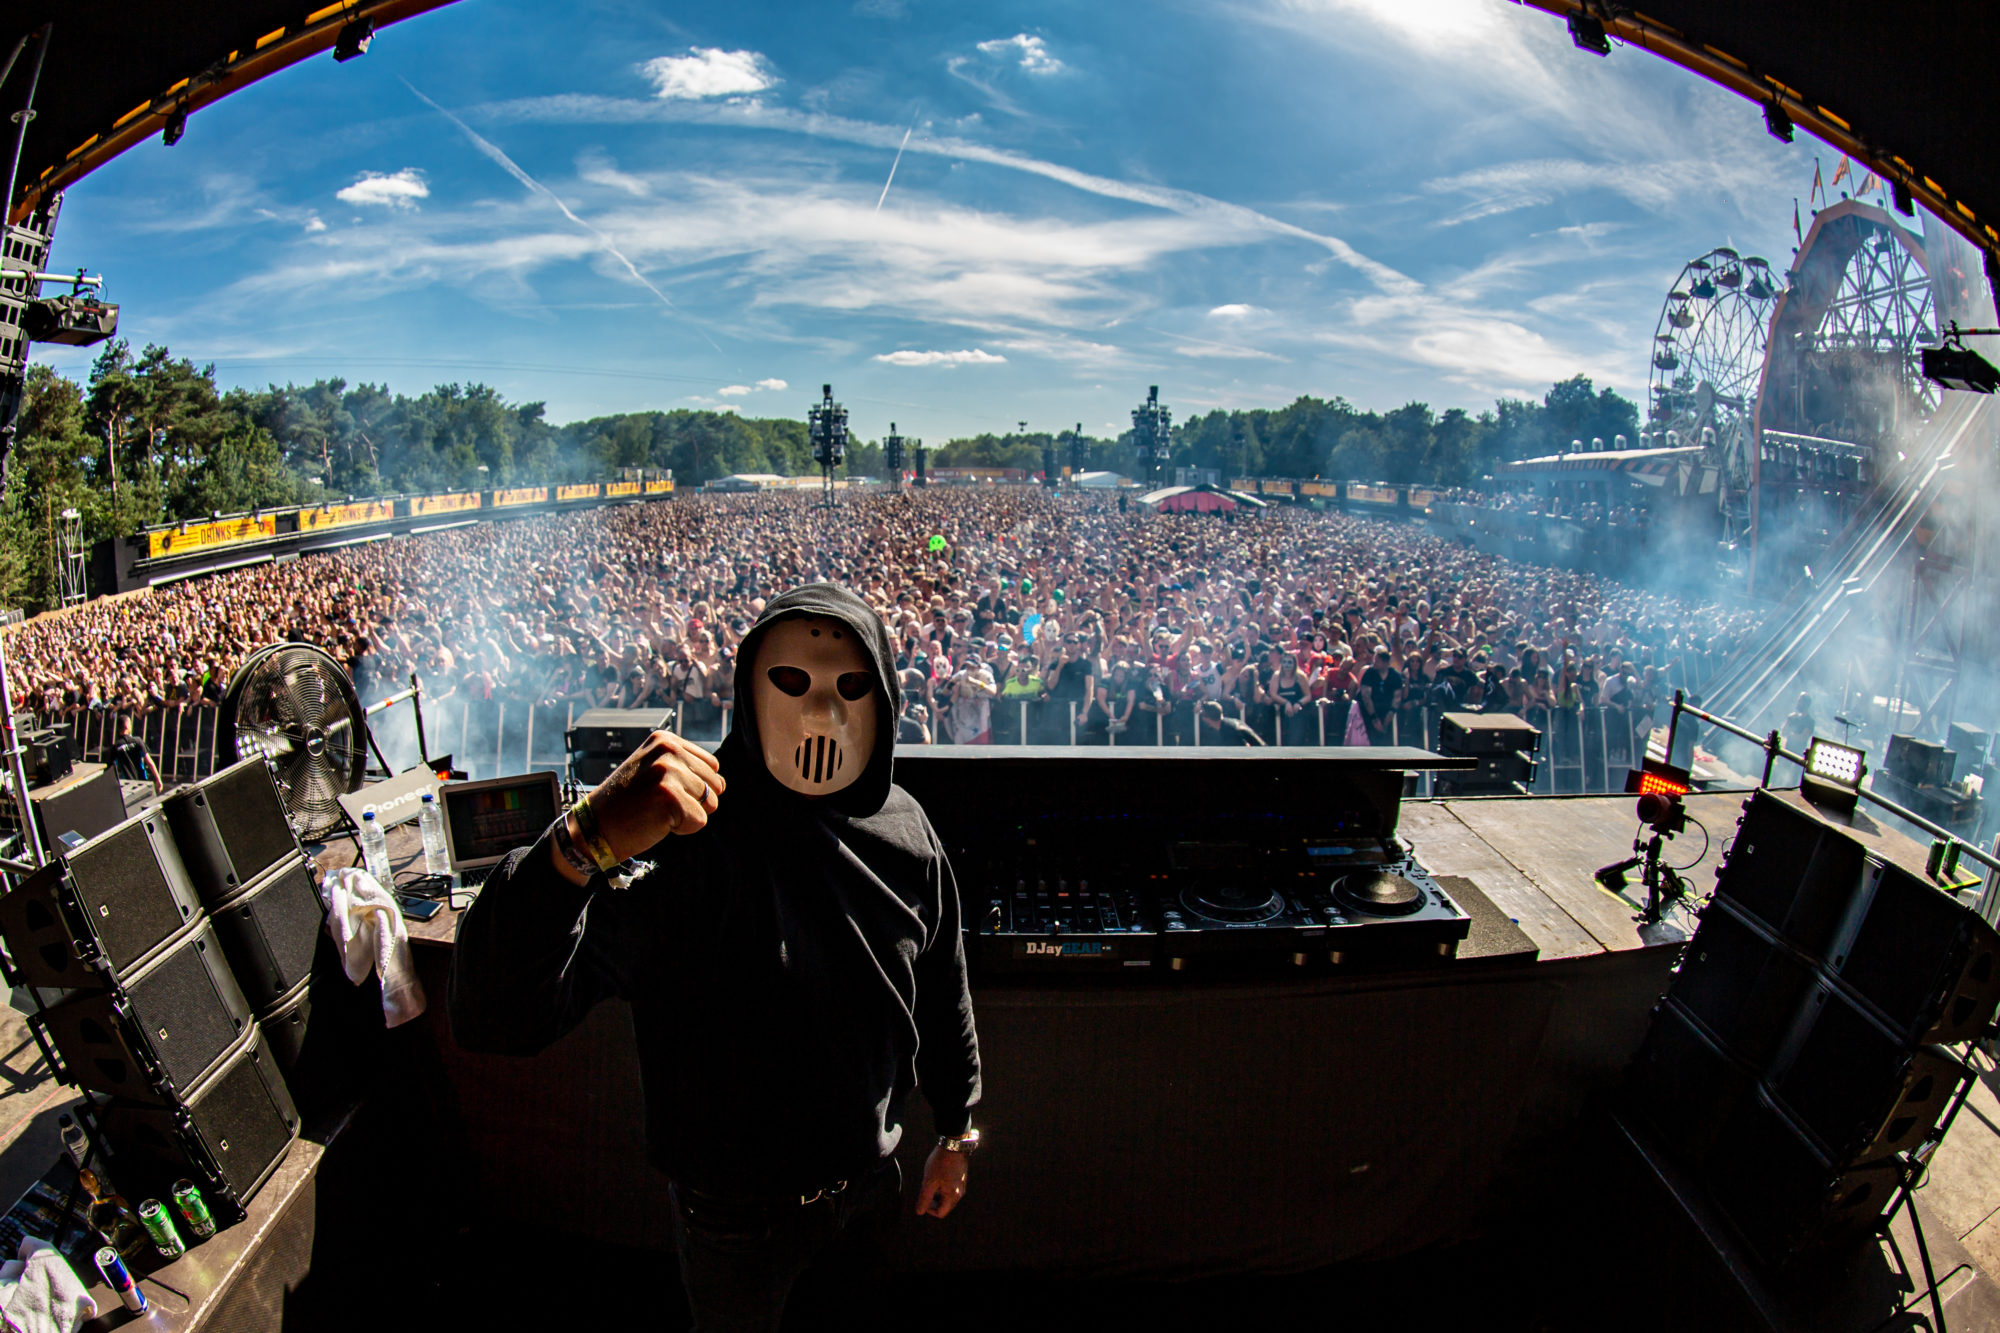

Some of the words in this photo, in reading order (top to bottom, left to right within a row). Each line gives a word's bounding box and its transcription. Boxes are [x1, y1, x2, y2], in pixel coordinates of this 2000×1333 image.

[338, 505, 361, 522] DRINKS
[201, 524, 232, 545] DRINKS
[362, 783, 432, 814] Pioneer
